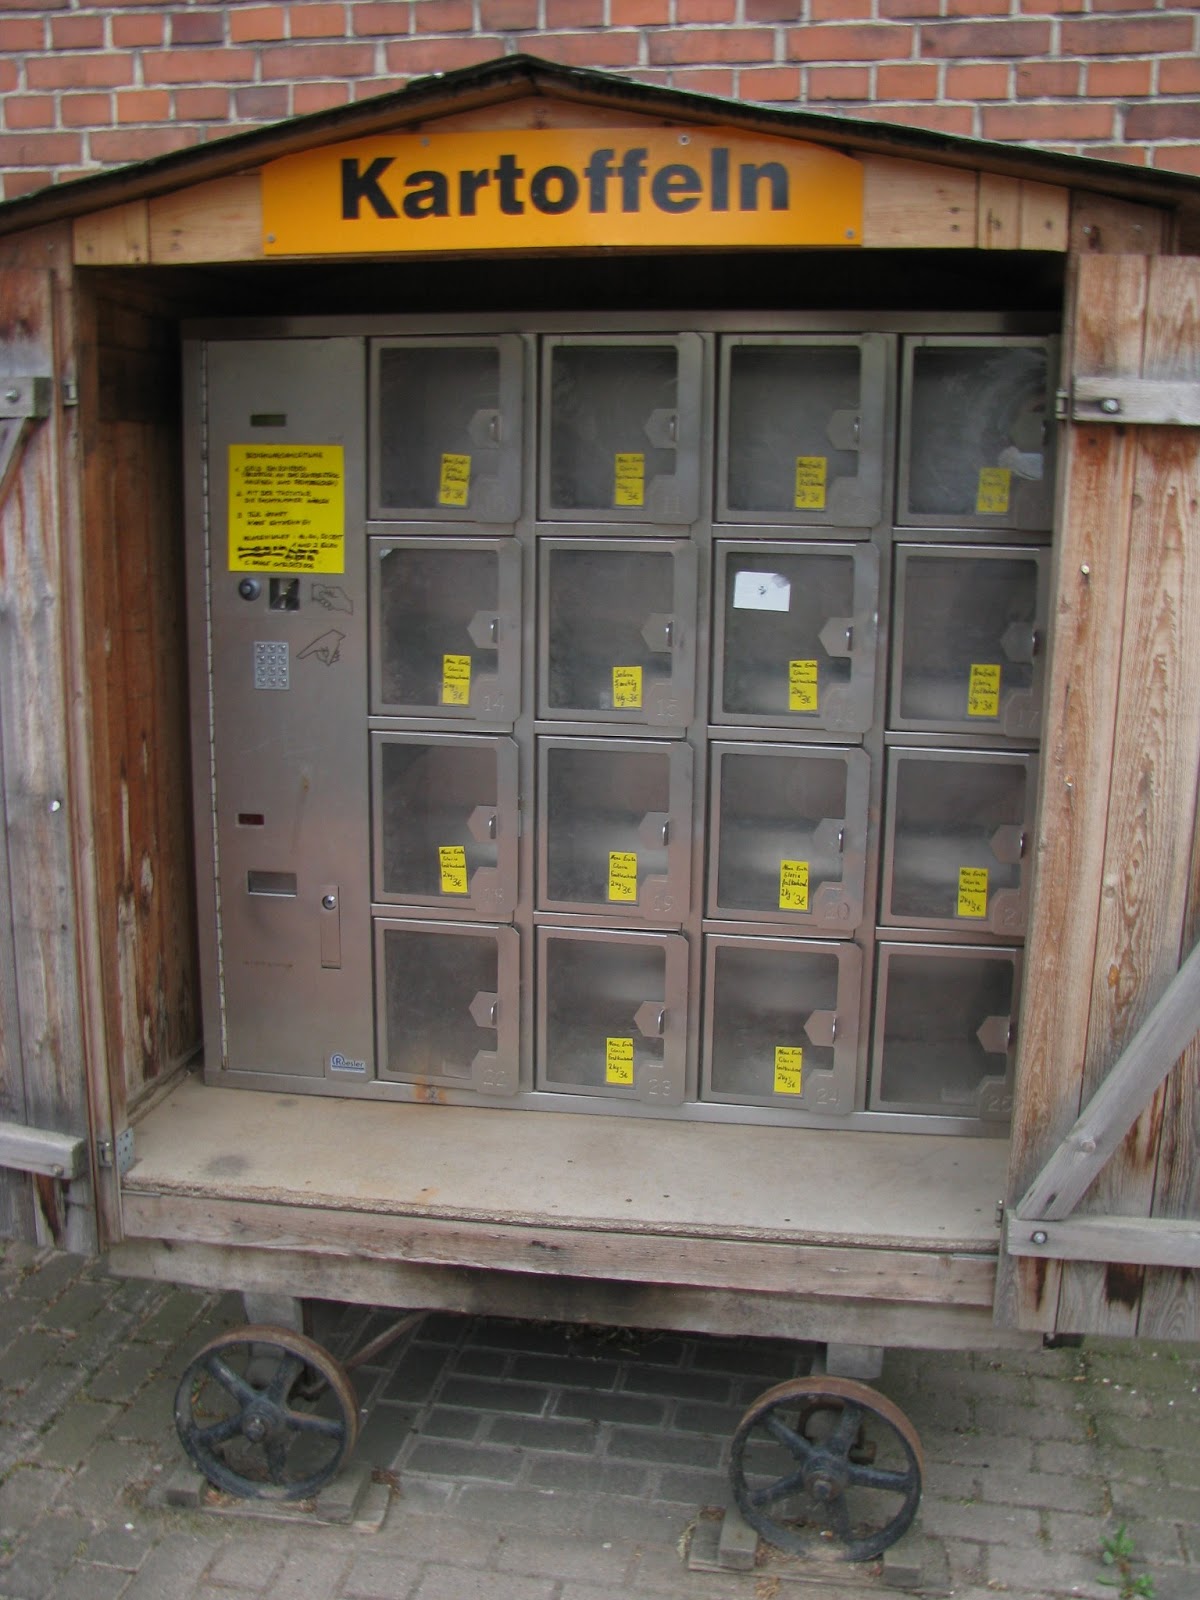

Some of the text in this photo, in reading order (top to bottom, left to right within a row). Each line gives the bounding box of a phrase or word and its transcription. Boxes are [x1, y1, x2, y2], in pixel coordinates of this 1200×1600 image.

[340, 147, 790, 220] Kartoffeln
[331, 1054, 364, 1068] Roesler
[647, 1078, 673, 1097] 23
